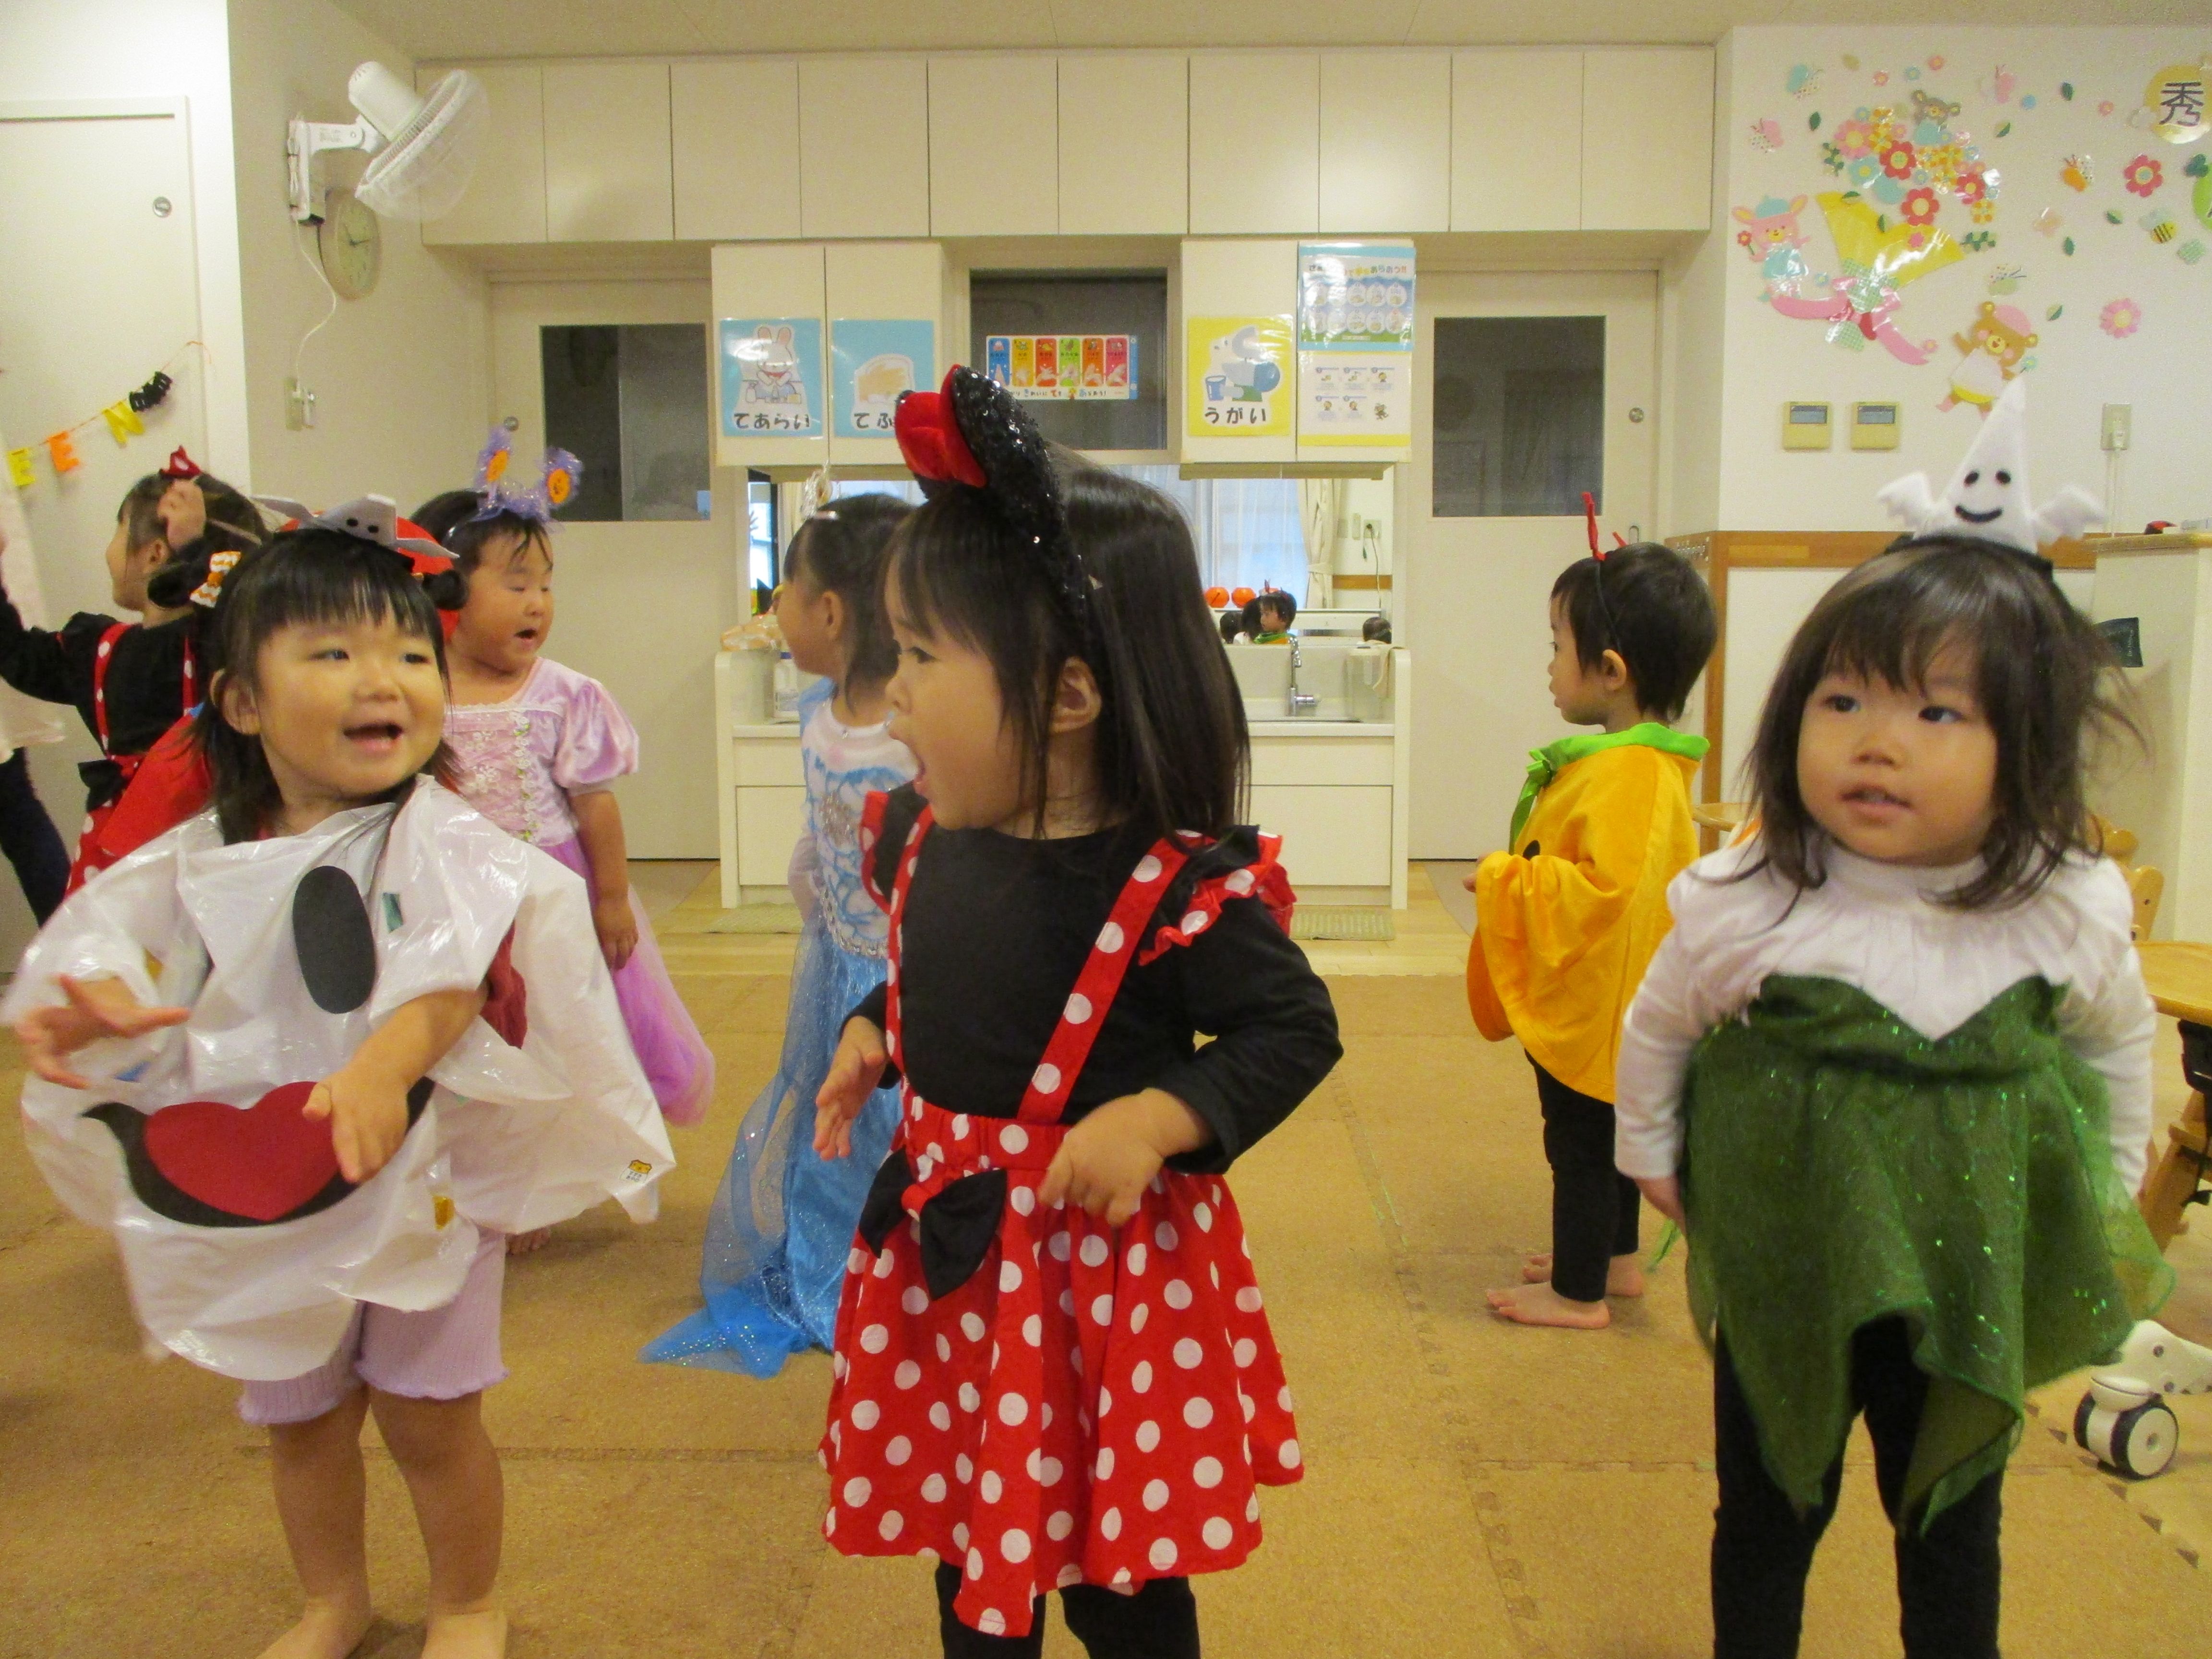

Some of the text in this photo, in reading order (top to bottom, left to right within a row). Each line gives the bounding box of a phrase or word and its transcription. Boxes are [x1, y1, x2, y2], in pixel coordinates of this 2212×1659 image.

[2159, 82, 2204, 127] 秀
[734, 413, 810, 430] てあらい
[854, 413, 895, 429] てふ
[1204, 407, 1266, 424] うがい
